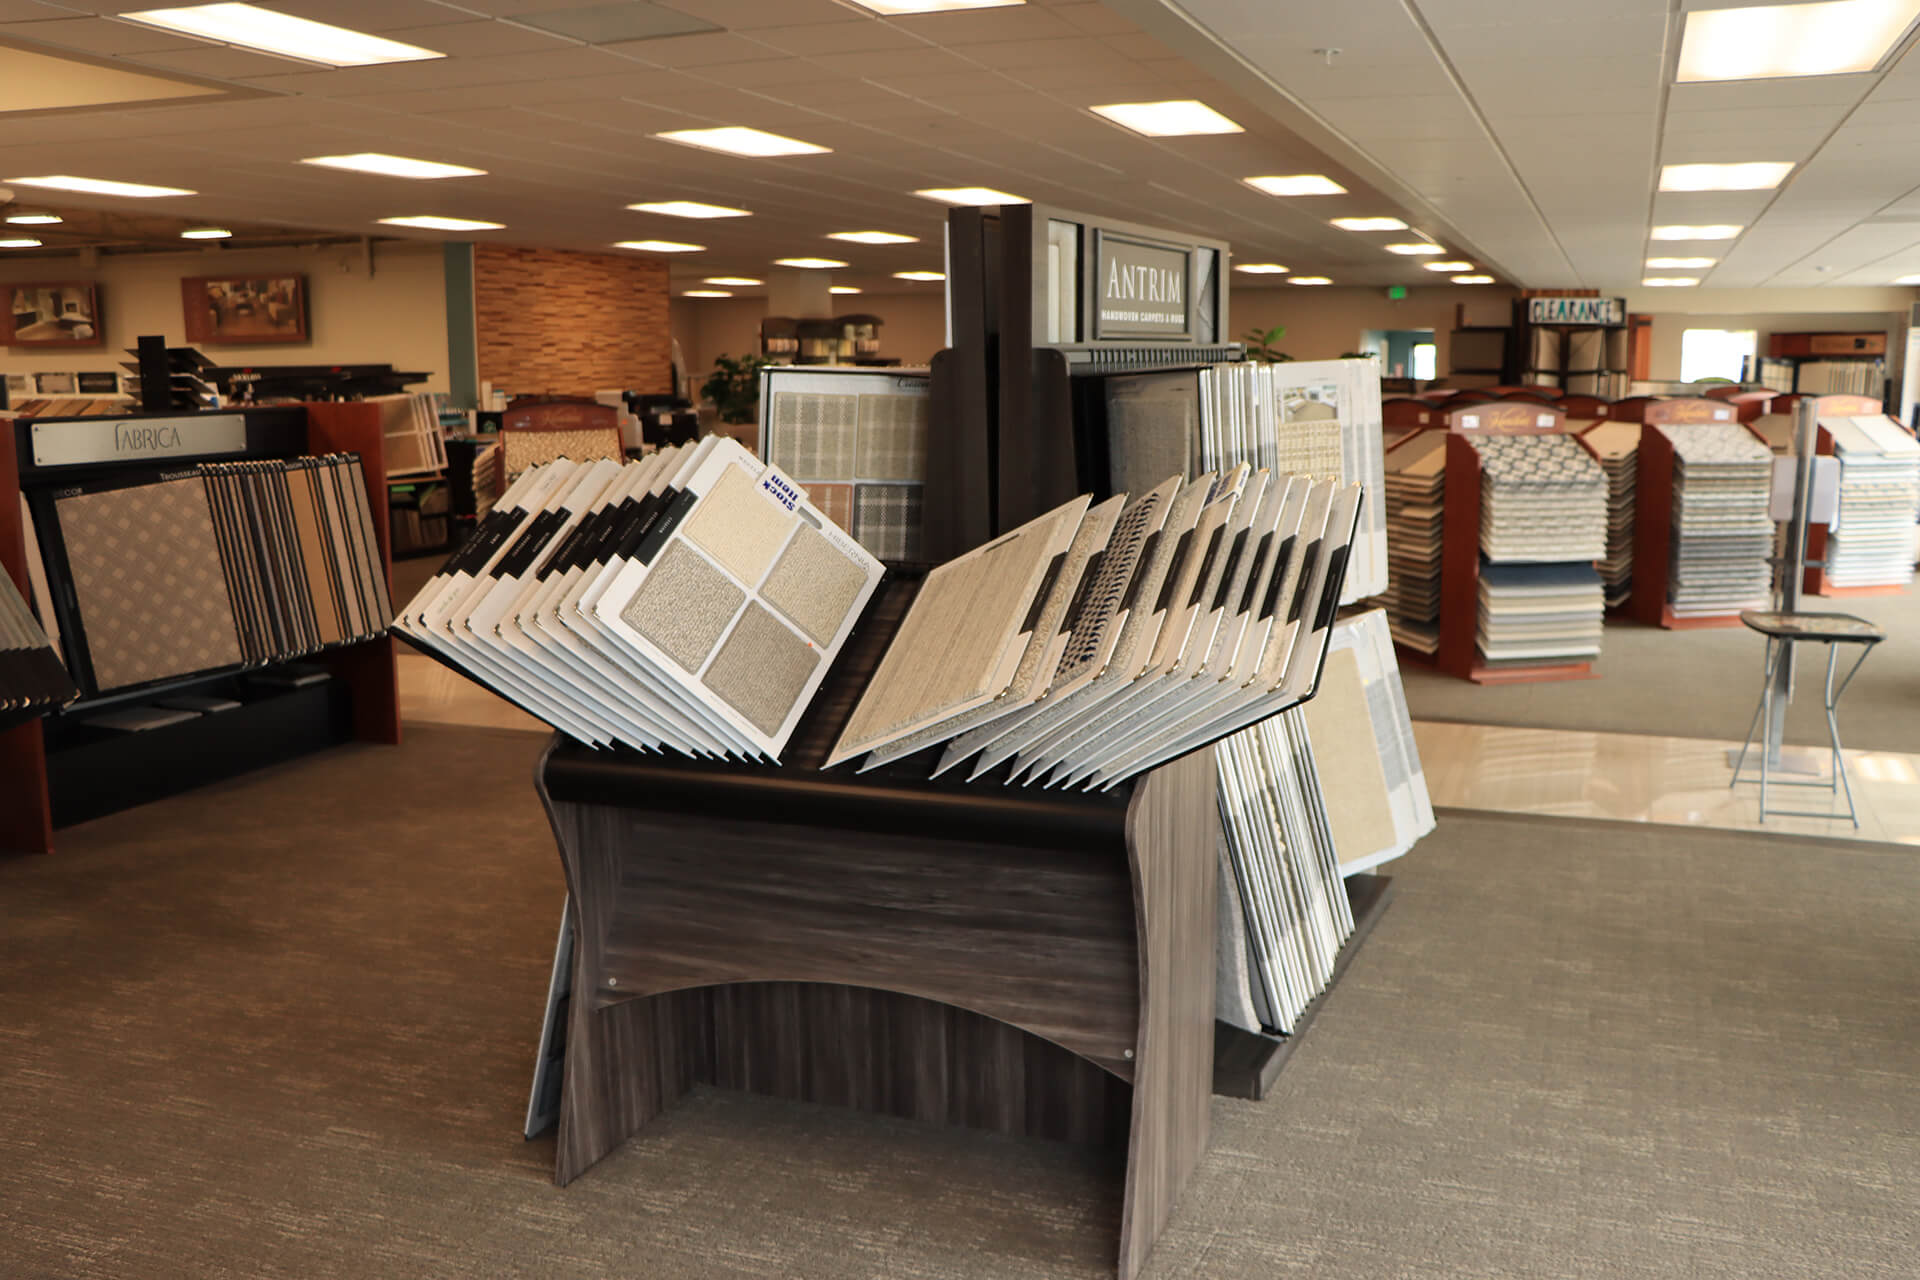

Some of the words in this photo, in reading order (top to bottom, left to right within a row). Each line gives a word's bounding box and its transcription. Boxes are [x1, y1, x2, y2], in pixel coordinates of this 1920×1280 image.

[1106, 255, 1181, 304] ANTRIM
[1533, 299, 1611, 322] CLEARANCE
[115, 422, 181, 451] FABRICA
[762, 479, 796, 512] Stock
[770, 474, 799, 501] Item
